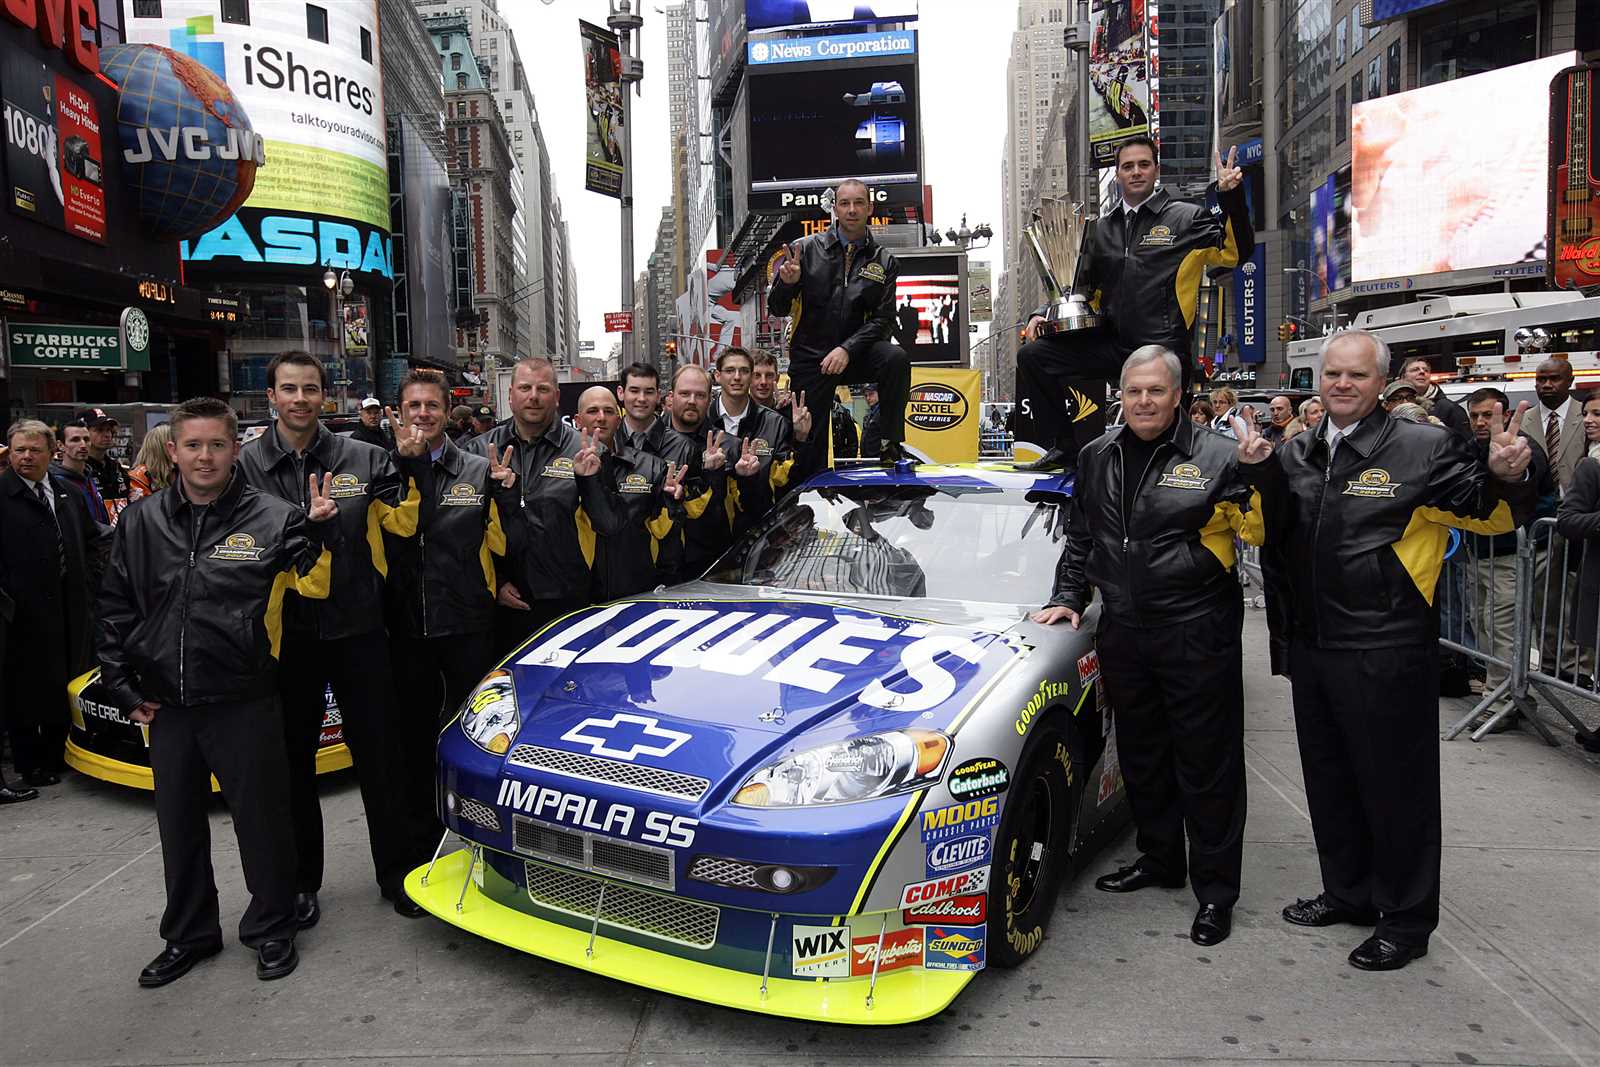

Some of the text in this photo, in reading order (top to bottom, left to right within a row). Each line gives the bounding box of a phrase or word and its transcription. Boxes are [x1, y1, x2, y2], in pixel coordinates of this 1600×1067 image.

[771, 36, 910, 59] News Corporation
[243, 43, 373, 116] iShares
[123, 126, 211, 164] JVC
[1246, 143, 1262, 160] NYC
[781, 188, 888, 207] Panaic
[180, 213, 393, 280] ASDA
[1560, 243, 1598, 260] Hard
[1353, 281, 1400, 294] REUTERS
[1244, 278, 1255, 345] REUTERS
[12, 333, 118, 348] STARBUCKS
[33, 346, 101, 359] COFFEE
[1219, 371, 1256, 381] CHASE
[911, 403, 955, 414] NEXTEL
[923, 392, 953, 402] NASCAR
[1015, 679, 1069, 737] GOODYEAR
[955, 760, 997, 776] GOODYEAR
[950, 769, 1008, 795] Gatorback
[496, 778, 700, 849] IMPALA SS
[922, 796, 998, 832] MOOG
[926, 815, 998, 841] CHASSIS PARTS
[931, 837, 986, 867] CLEVITE
[905, 874, 970, 905] COMP
[794, 929, 846, 959] WIX
[931, 938, 984, 953] SUNOCO
[795, 958, 847, 974] FILTERS
